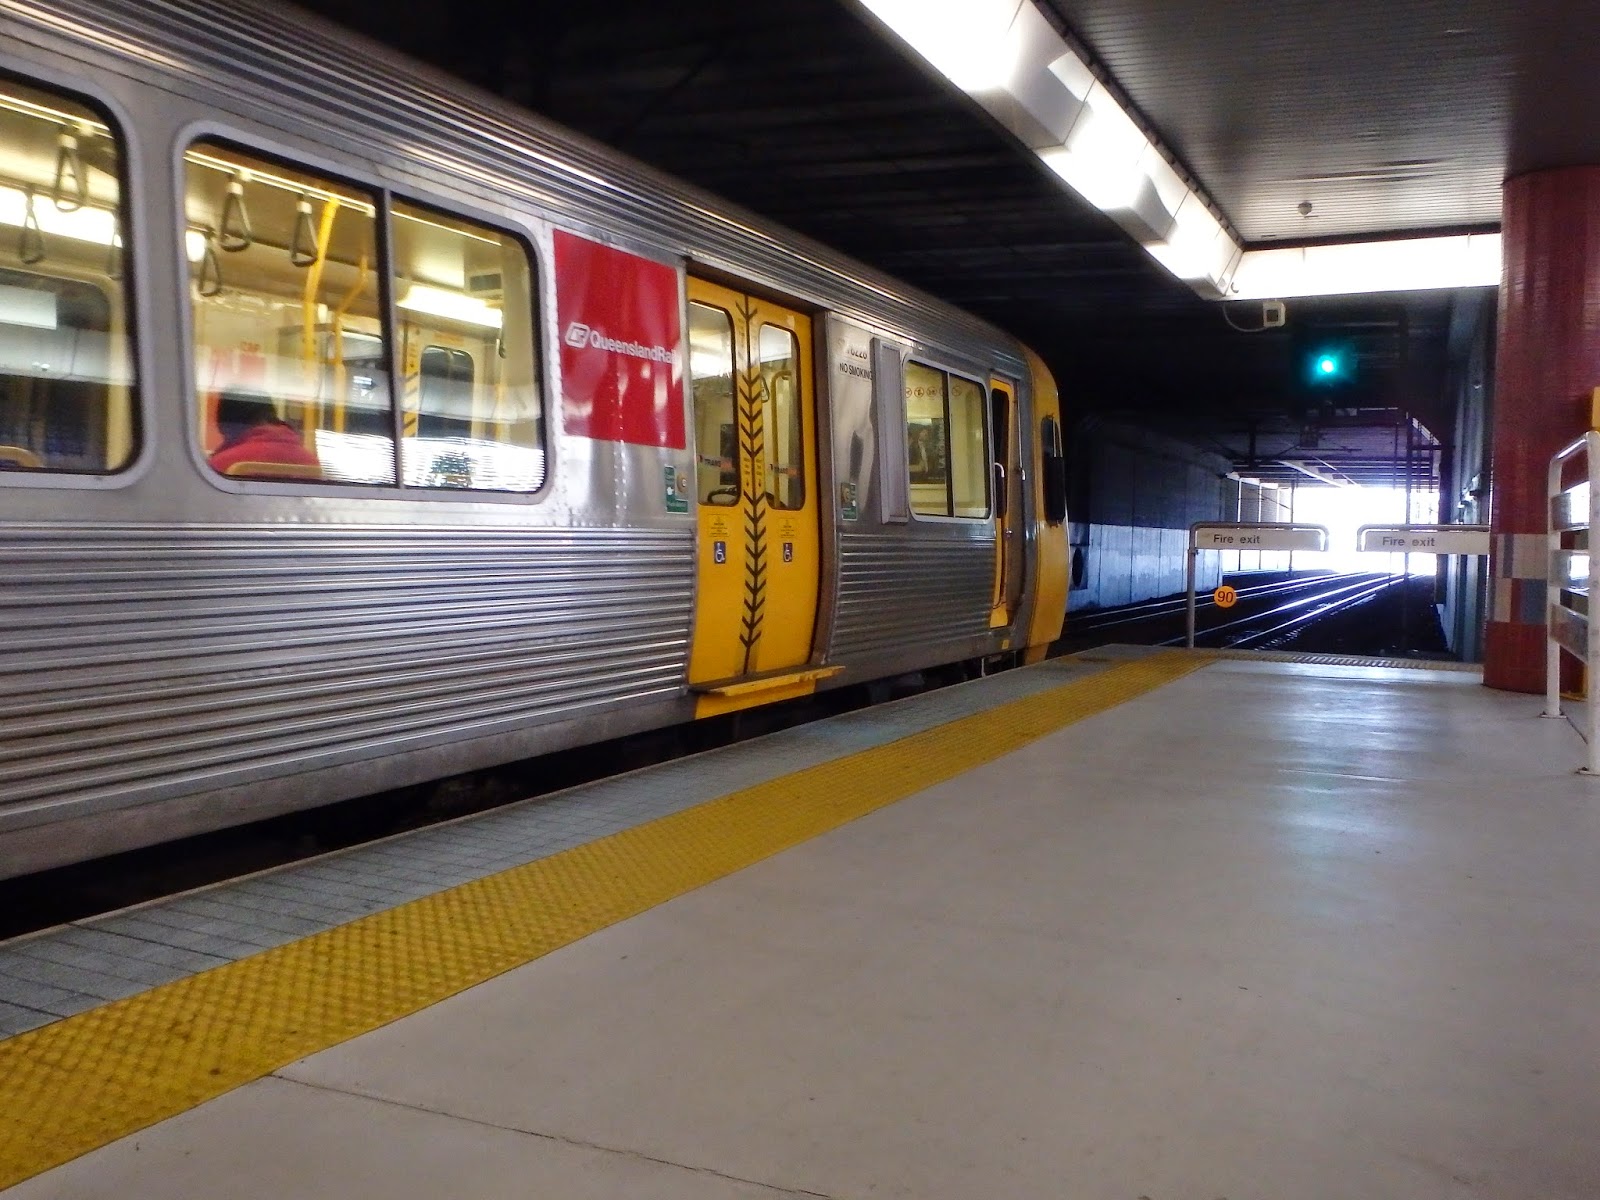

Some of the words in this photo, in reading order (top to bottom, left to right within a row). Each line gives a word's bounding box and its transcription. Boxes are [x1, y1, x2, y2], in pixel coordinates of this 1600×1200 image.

[839, 362, 848, 373] NO
[1213, 534, 1234, 544] Fire
[1239, 535, 1260, 544] exit
[1382, 536, 1405, 546] Fire
[1411, 537, 1435, 547] exit
[1217, 590, 1234, 603] 90
